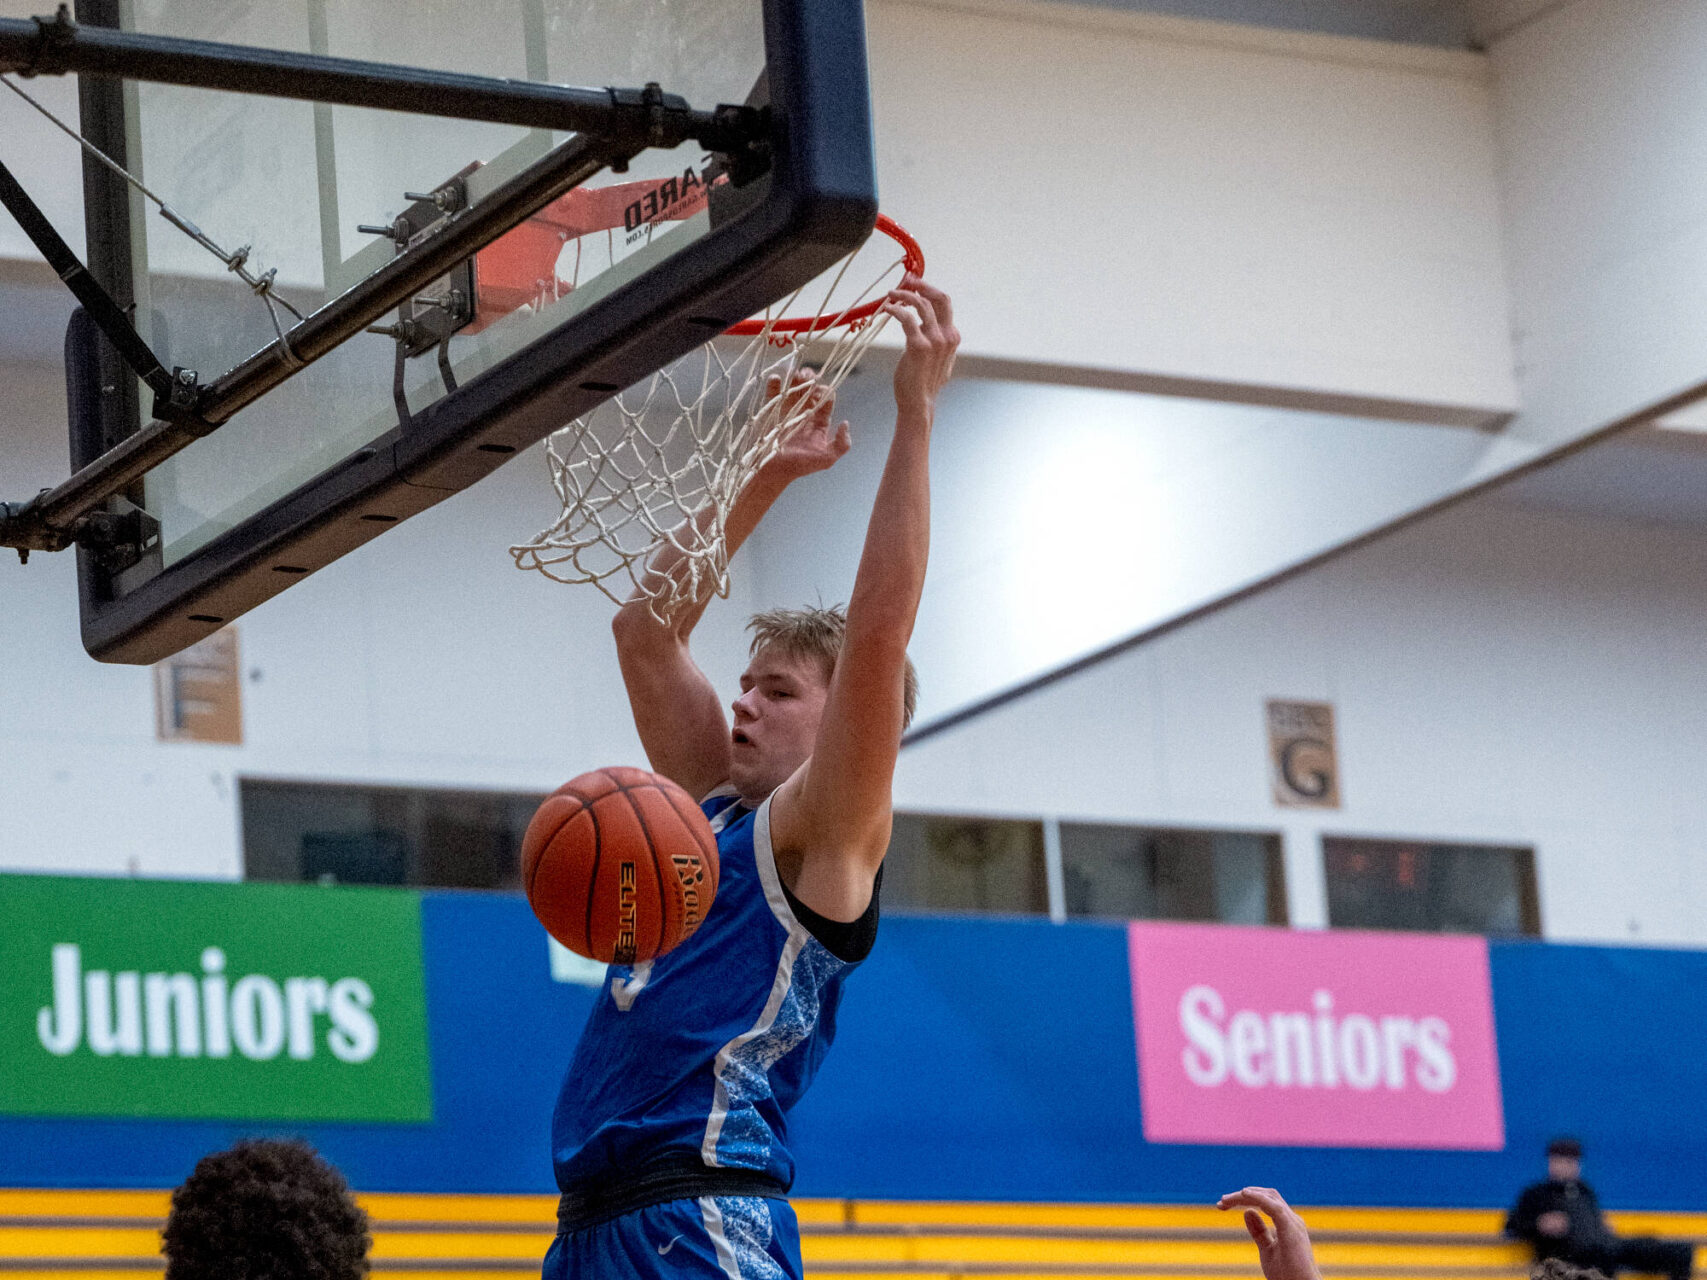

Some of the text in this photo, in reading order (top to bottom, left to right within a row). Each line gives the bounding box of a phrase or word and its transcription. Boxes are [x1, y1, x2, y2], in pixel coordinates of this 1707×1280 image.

[1280, 737, 1329, 799] G
[618, 860, 638, 949] ELITE
[36, 942, 379, 1063] Juniors
[1179, 984, 1456, 1093] Seniors
